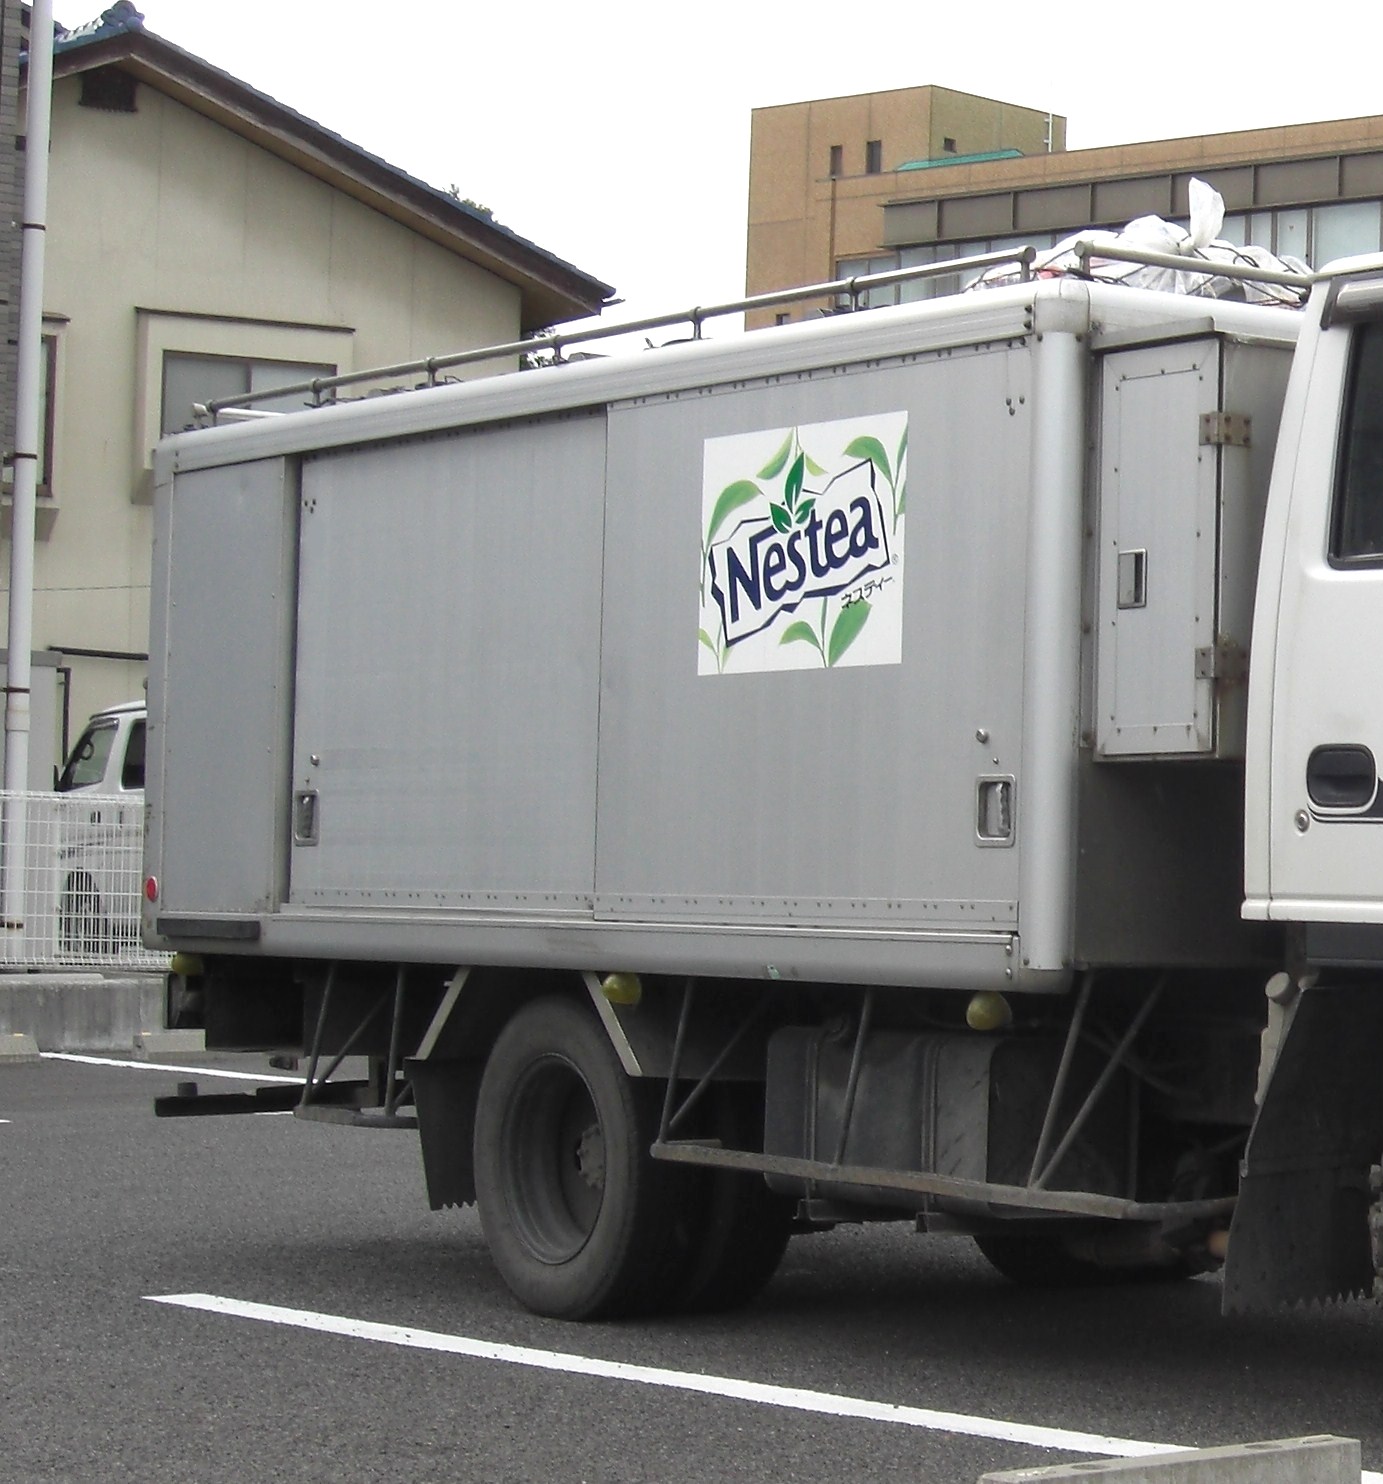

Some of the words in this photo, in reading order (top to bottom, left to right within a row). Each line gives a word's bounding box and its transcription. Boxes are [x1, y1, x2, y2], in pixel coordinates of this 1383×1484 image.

[727, 496, 880, 624] Nestea
[841, 576, 893, 608] ネスティー
